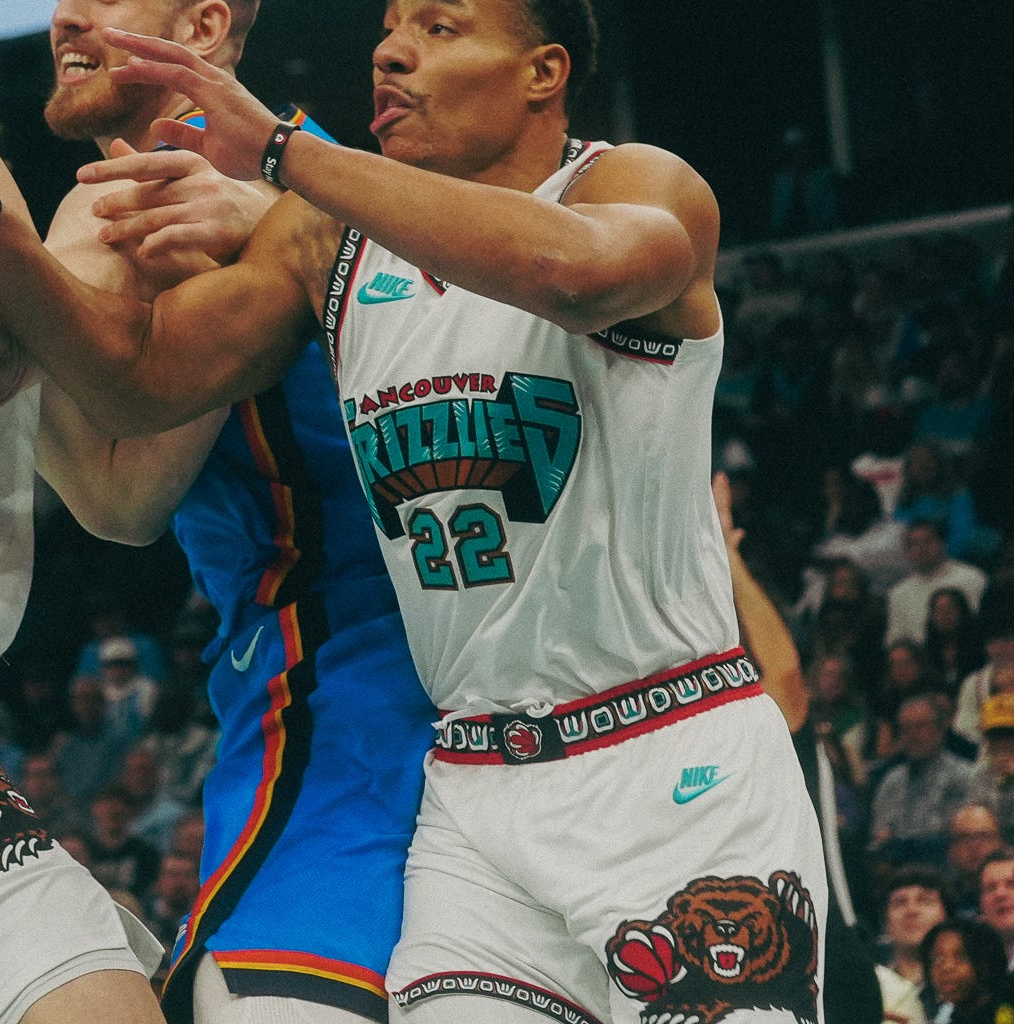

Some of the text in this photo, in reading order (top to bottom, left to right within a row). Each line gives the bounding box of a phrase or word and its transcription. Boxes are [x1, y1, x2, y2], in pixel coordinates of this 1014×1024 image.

[262, 157, 277, 176] Stay
[368, 272, 414, 296] NIKE
[360, 372, 498, 415] ANCOUVER
[344, 371, 582, 541] RIZZLIES
[407, 502, 516, 592] 22
[680, 765, 719, 789] NIKE
